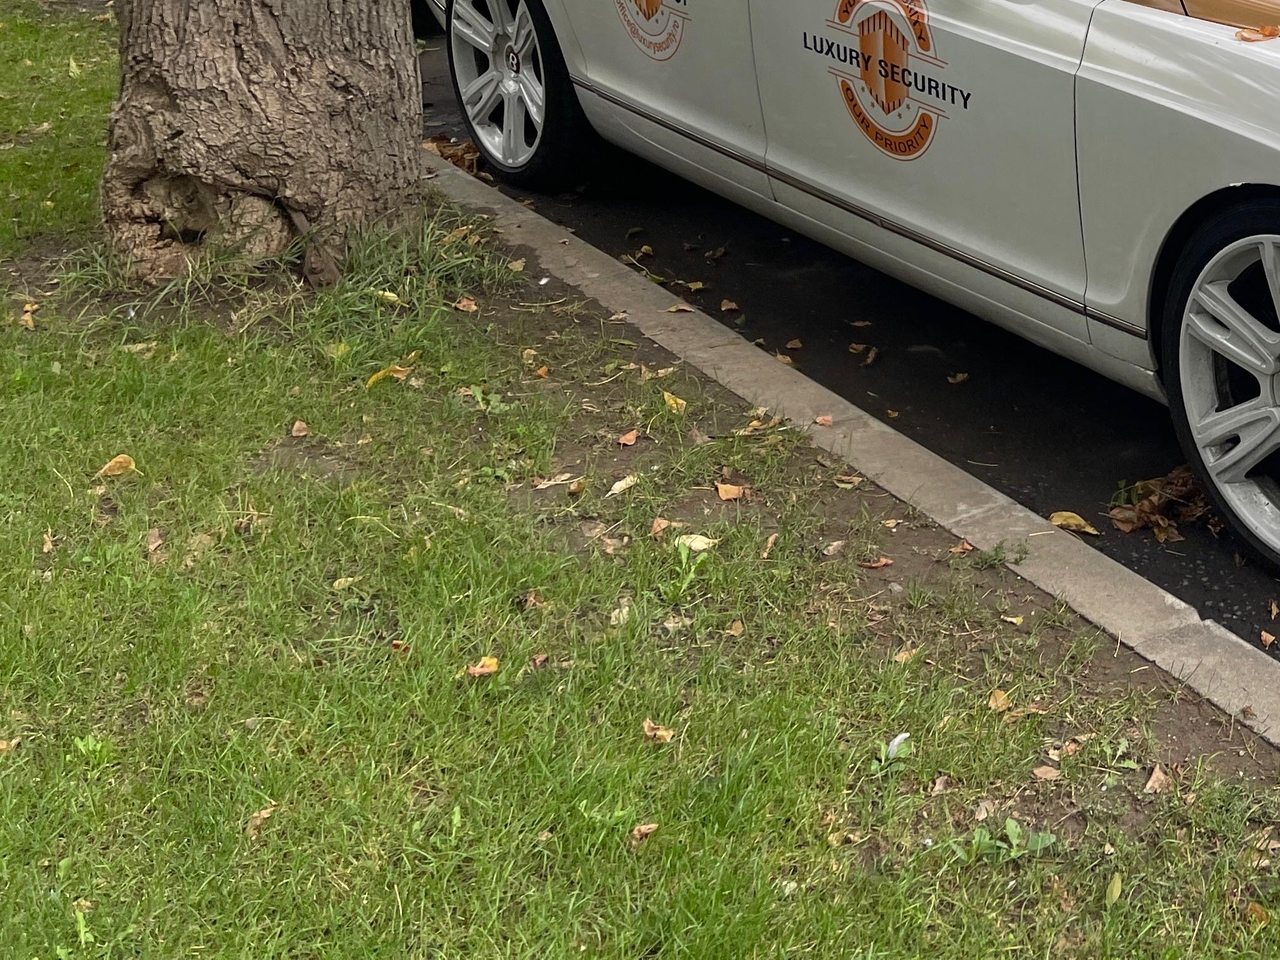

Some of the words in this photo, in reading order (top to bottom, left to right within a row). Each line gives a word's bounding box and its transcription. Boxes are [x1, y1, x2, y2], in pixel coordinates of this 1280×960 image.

[803, 31, 873, 72] LUXURY
[878, 59, 972, 110] SECURITY
[845, 86, 871, 132] OUR
[874, 116, 929, 153] PRIORITY
